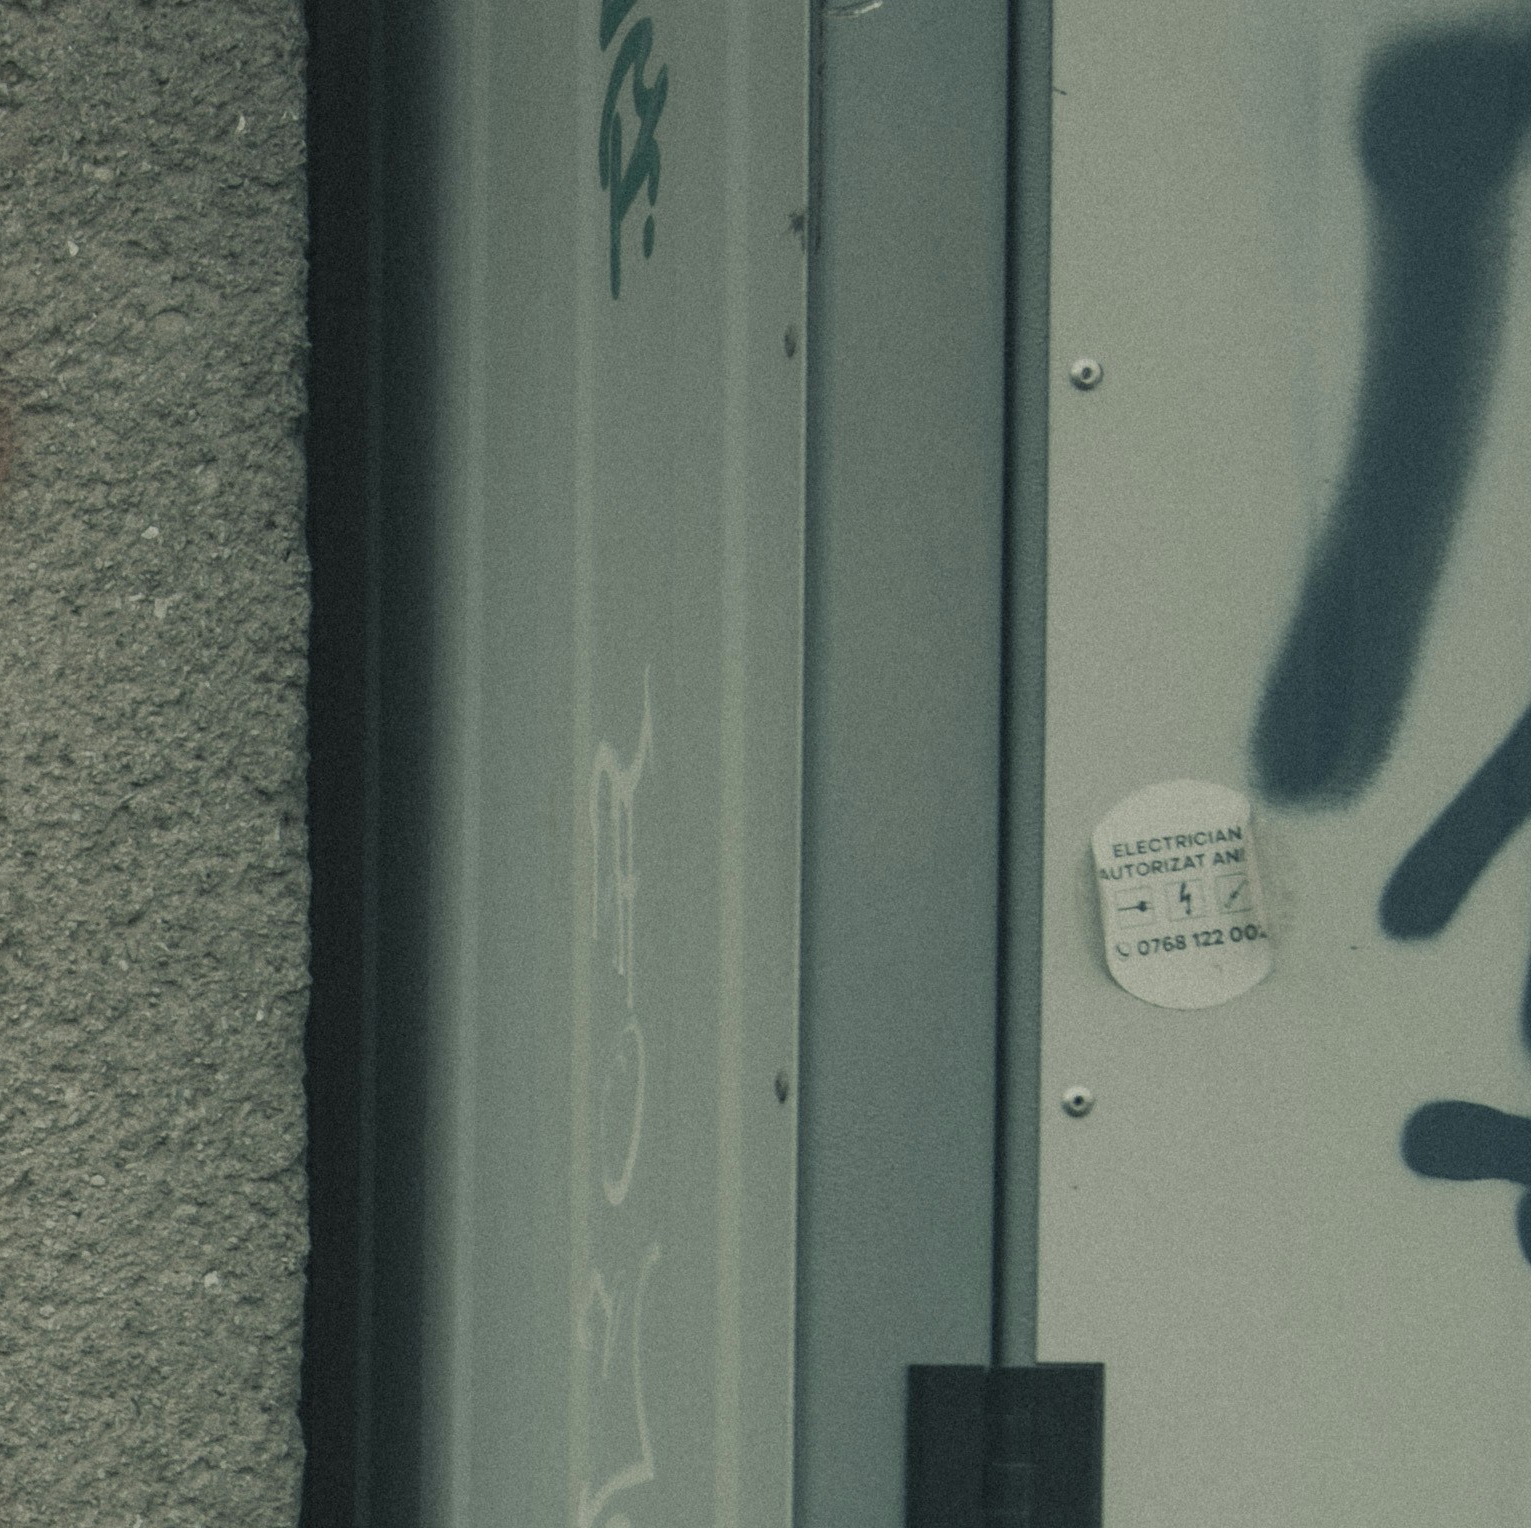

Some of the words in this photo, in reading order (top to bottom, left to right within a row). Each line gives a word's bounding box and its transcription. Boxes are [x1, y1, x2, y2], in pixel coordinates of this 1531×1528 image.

[1112, 826, 1242, 858] ELECTRICIAN
[1135, 933, 1188, 956] 0768
[1191, 928, 1225, 949] 122
